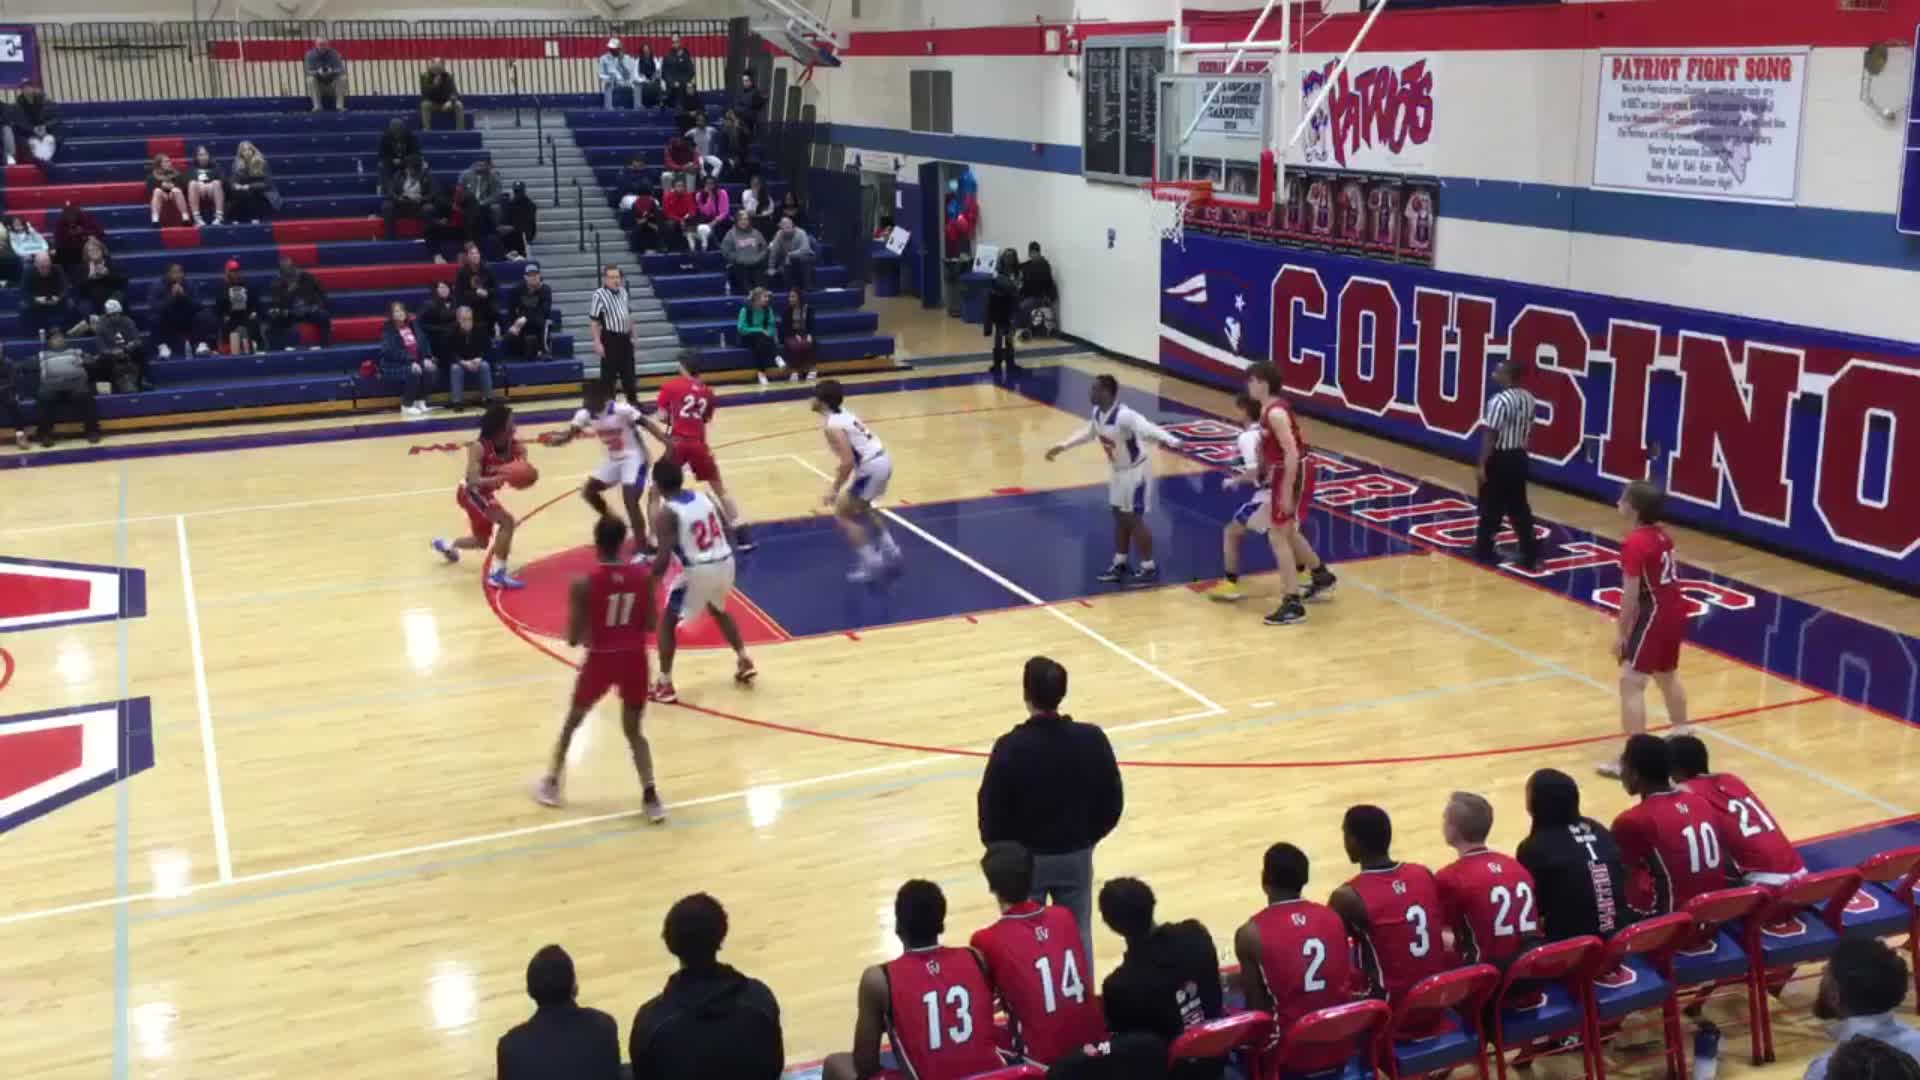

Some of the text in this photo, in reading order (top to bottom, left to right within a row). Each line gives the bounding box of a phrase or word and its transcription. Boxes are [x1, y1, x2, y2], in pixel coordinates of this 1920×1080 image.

[1612, 57, 1792, 82] PATRIOT FIGHT SONG
[679, 394, 707, 419] 23
[689, 512, 722, 552] 24
[605, 592, 636, 628] 11
[1728, 796, 1776, 838] 21
[1682, 821, 1721, 873] 10
[1406, 904, 1430, 957] 3
[1490, 881, 1537, 936] 22
[1034, 949, 1085, 1014] 14
[1303, 937, 1326, 992] 2
[922, 985, 974, 1050] 13
